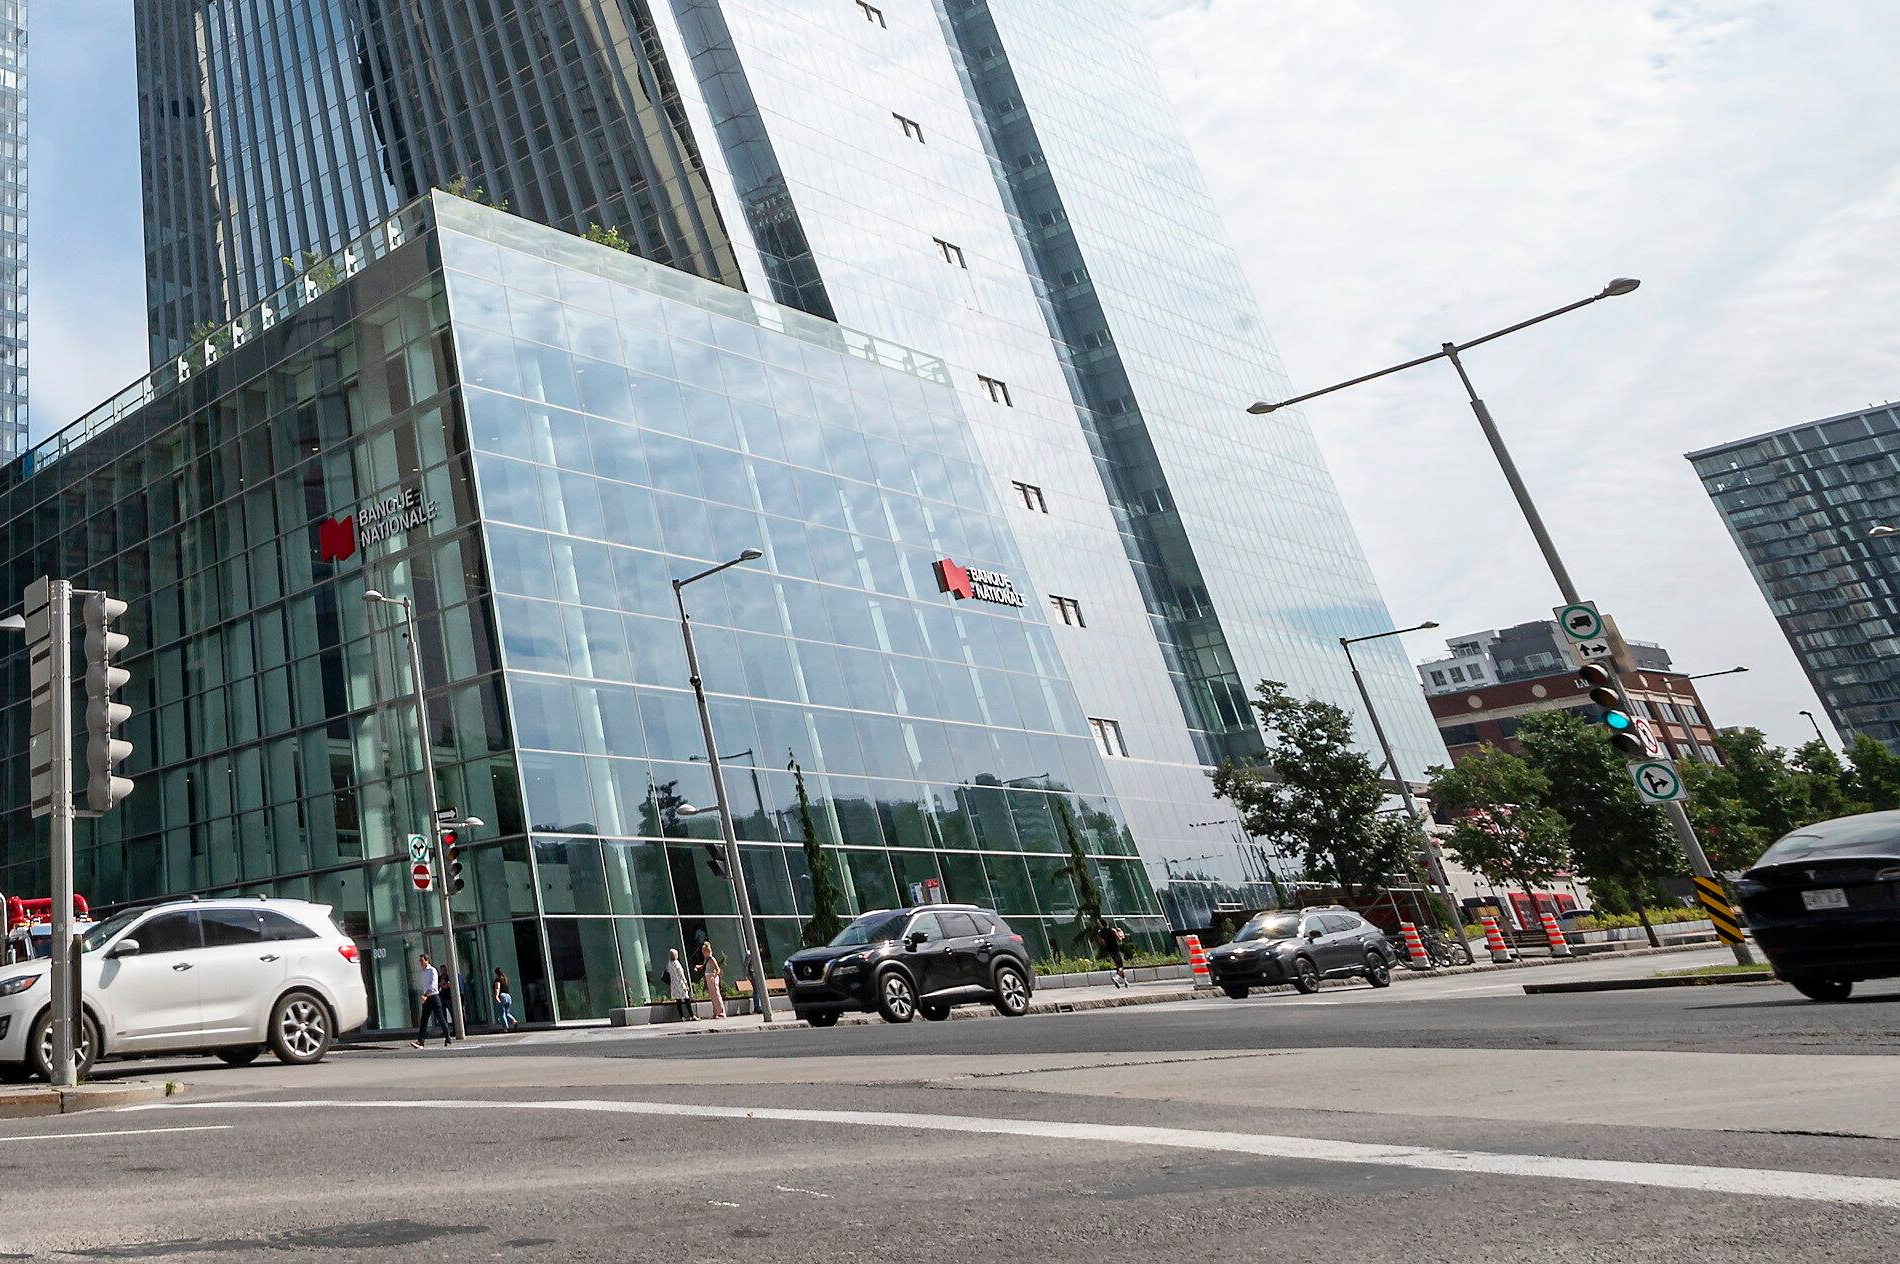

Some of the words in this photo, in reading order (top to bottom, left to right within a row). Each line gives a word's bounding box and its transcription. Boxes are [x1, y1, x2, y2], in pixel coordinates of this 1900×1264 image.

[358, 488, 418, 527] BANQUE
[361, 501, 438, 548] NATIONALE
[970, 567, 1012, 588] BANQUE
[976, 585, 1028, 607] NATIONALE
